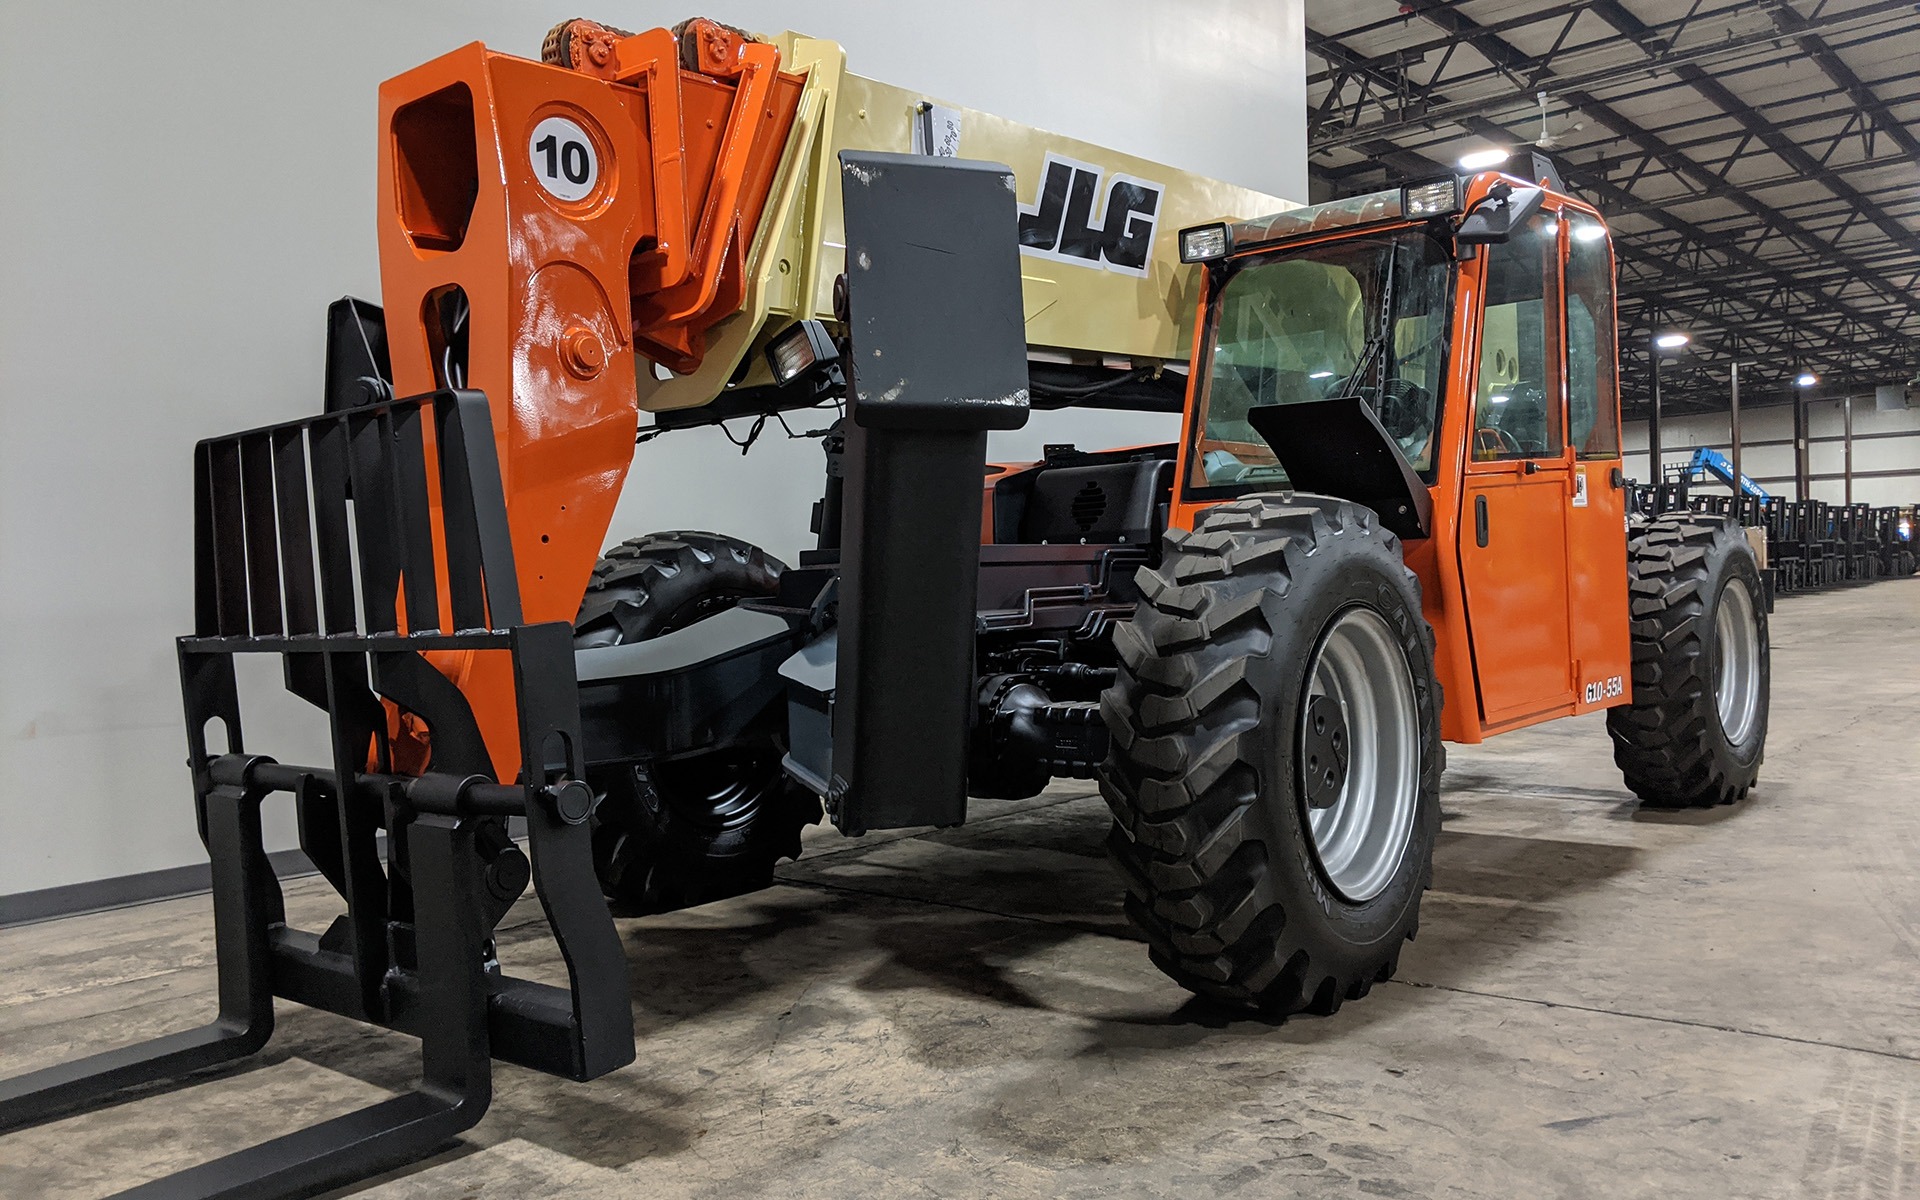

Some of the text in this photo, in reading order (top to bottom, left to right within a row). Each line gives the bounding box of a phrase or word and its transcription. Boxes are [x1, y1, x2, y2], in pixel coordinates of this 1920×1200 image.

[536, 134, 590, 185] 10
[1018, 160, 1159, 270] JLG
[1585, 675, 1623, 704] G10-55A
